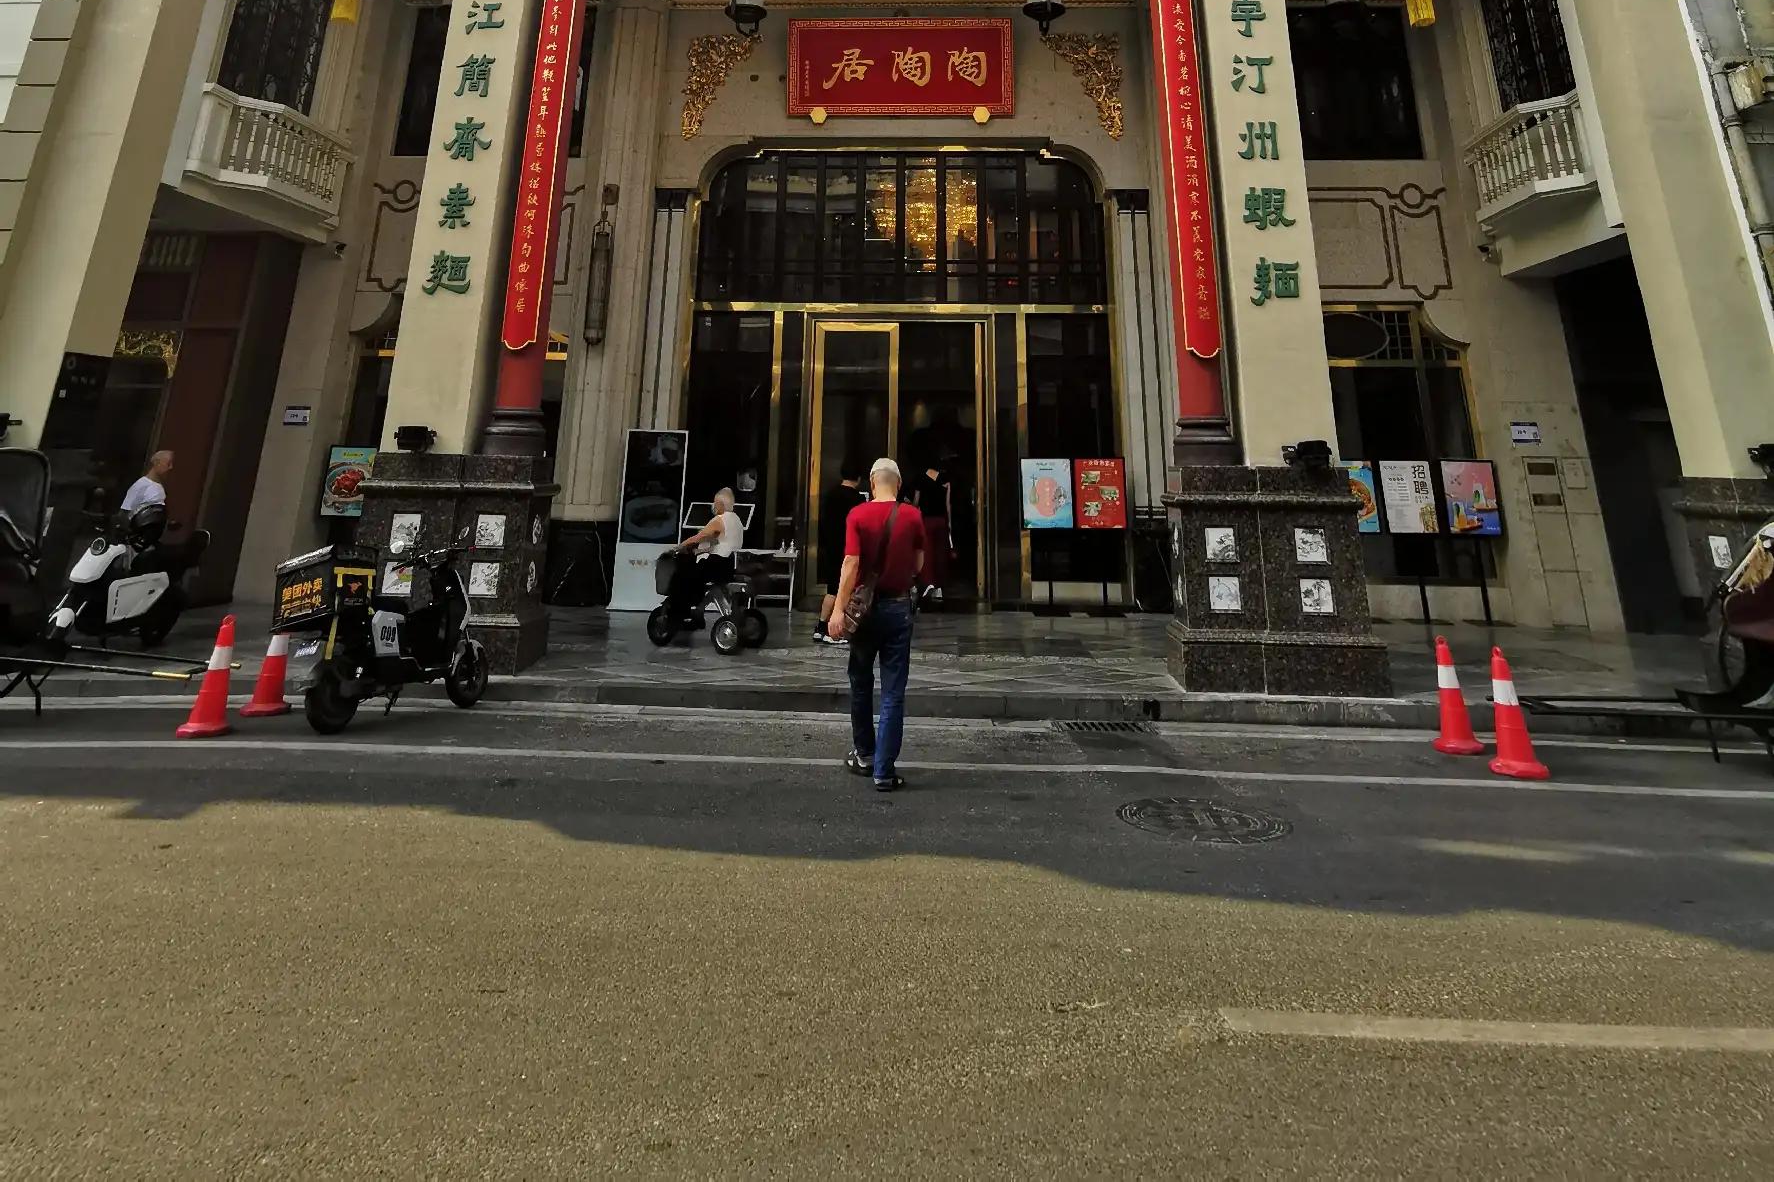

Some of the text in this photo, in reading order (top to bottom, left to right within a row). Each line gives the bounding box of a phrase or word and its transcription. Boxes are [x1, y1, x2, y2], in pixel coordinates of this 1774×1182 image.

[822, 46, 988, 90] 陶陶居
[1411, 464, 1429, 495] 招聘
[281, 577, 323, 602] 美团外卖
